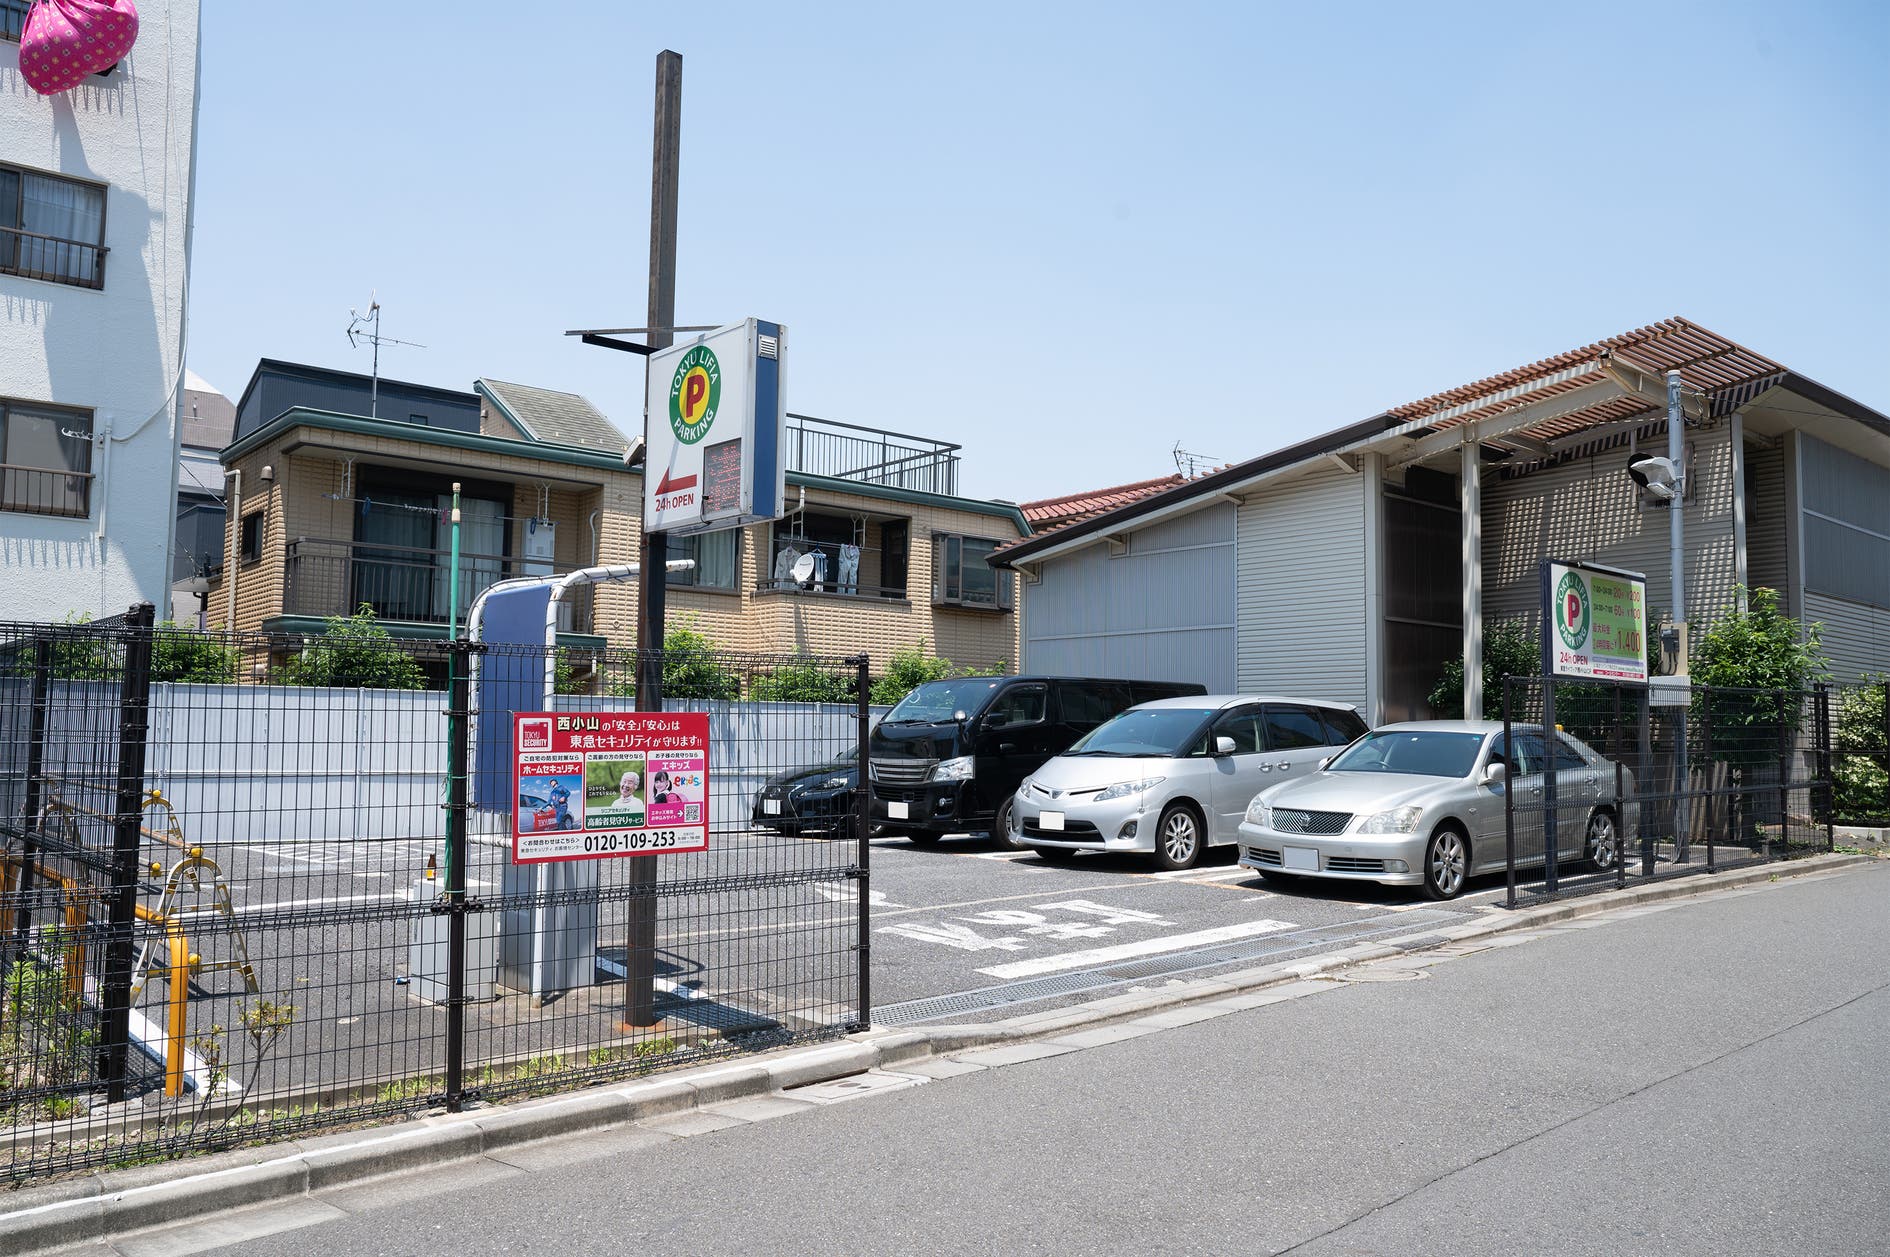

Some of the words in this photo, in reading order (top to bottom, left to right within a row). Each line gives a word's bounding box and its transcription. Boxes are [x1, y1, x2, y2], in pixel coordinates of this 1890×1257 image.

[671, 351, 698, 398] TOKYU
[699, 350, 718, 385] LIFIA
[686, 374, 706, 418] P
[674, 407, 714, 441] PARKING
[655, 497, 671, 513] 24h
[671, 493, 694, 509] OPEN
[1557, 575, 1574, 605] TOKYU
[1575, 577, 1588, 609] LIFIA
[1567, 594, 1580, 627] P
[1560, 624, 1587, 647] PARKING
[1560, 651, 1572, 664] 24h
[1572, 654, 1588, 665] OPEN
[557, 716, 680, 732] 西小山の「安全」「安心」は
[524, 731, 540, 739] TOKYU
[524, 738, 547, 747] SECURITY
[523, 754, 580, 762] ご自宅の防犯対策なら
[661, 760, 691, 770] エキッズ
[522, 764, 580, 775] ホームセキュリティ
[587, 816, 643, 827] 高齢者見守りサービス
[584, 831, 675, 852] 0120-109-253
